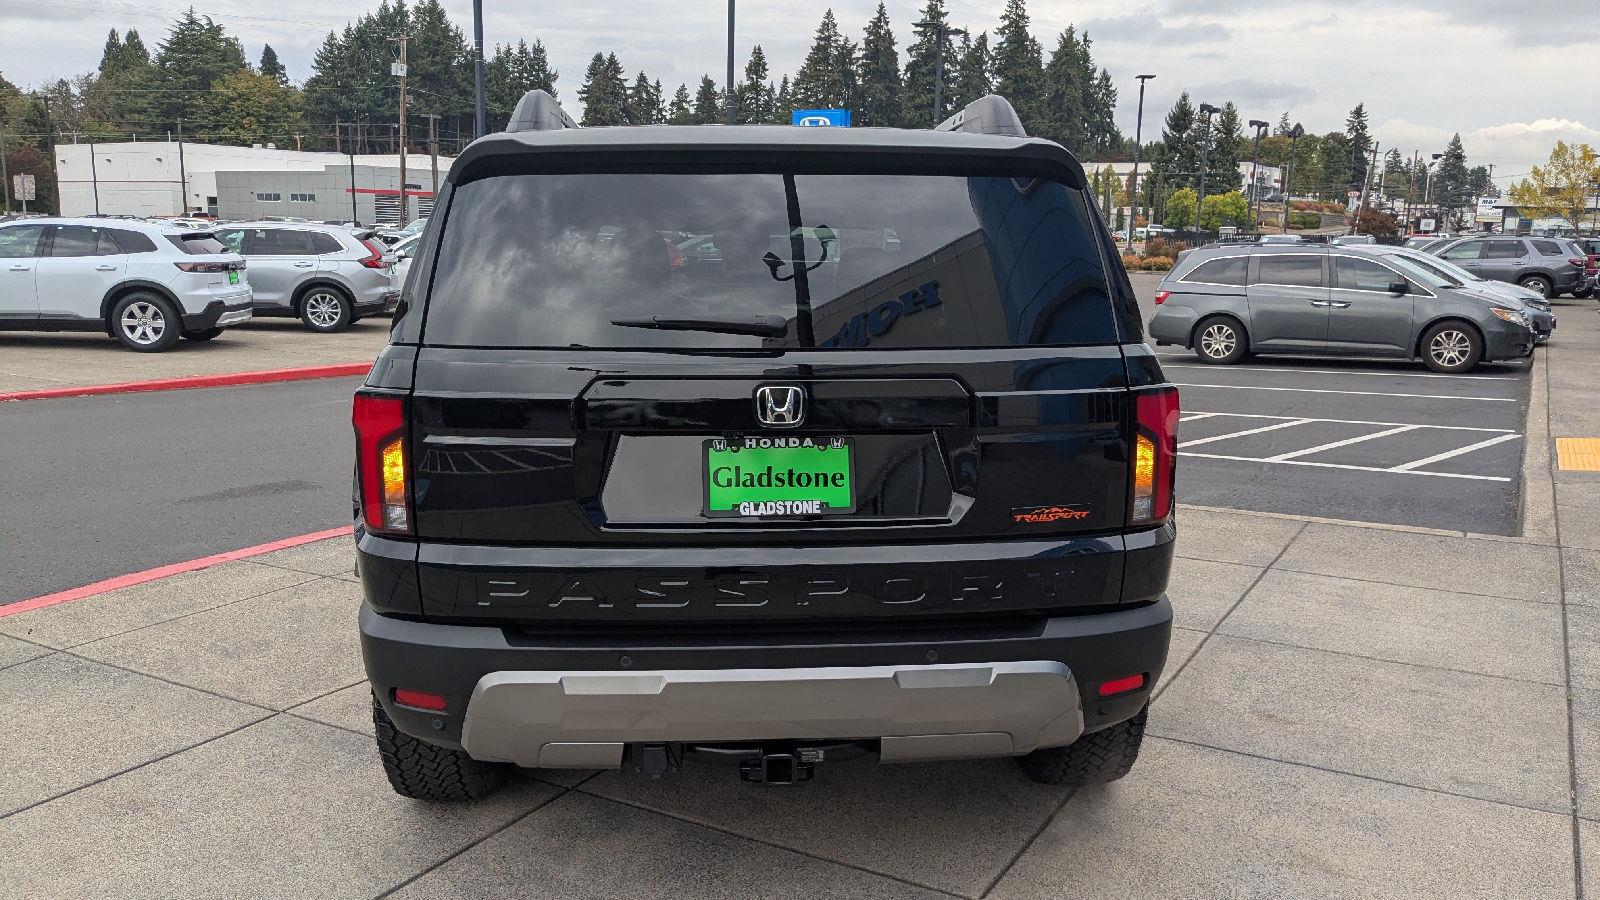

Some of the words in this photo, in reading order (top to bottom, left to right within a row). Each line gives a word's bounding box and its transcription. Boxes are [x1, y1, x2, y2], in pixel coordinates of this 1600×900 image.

[745, 437, 814, 449] HONDA
[712, 465, 845, 488] Gladstone
[739, 500, 822, 516] GLADSTONE
[1013, 509, 1090, 523] TRAILSPORT
[475, 570, 1078, 608] PASSPORT
